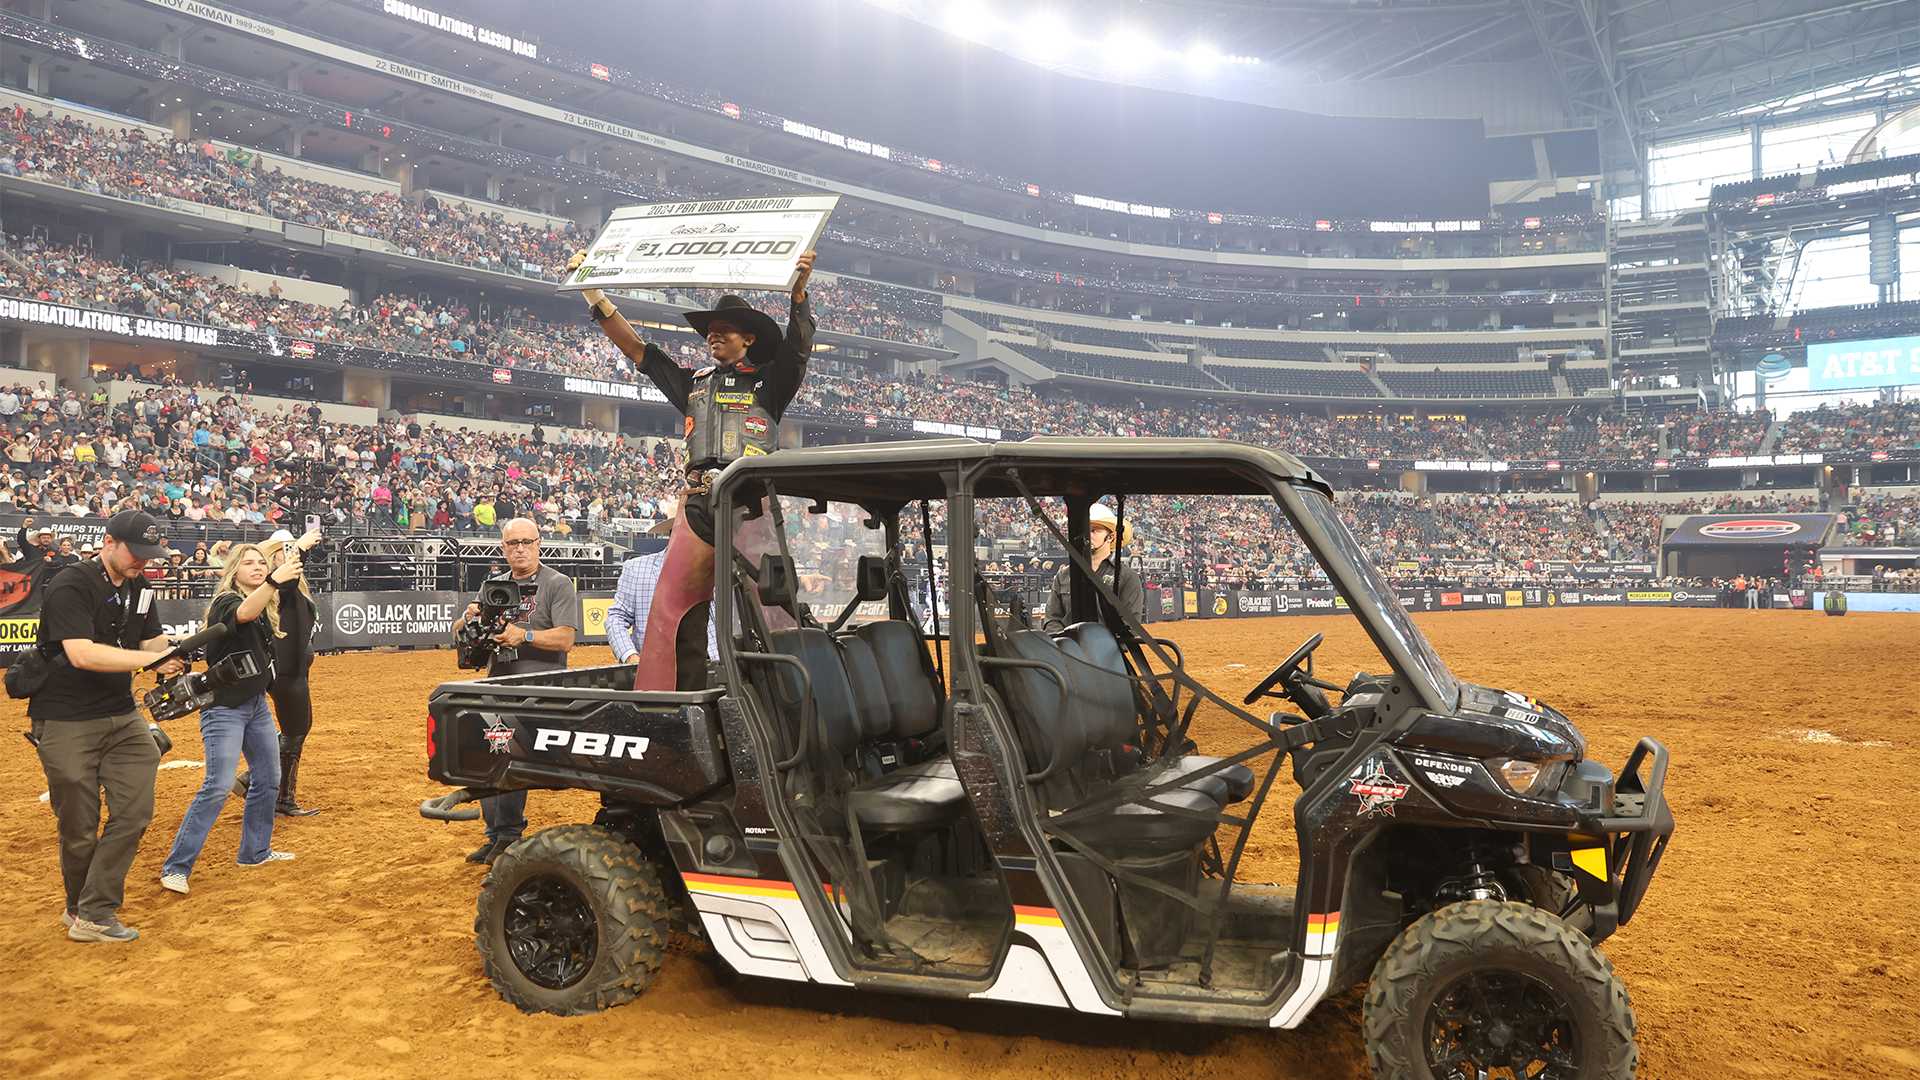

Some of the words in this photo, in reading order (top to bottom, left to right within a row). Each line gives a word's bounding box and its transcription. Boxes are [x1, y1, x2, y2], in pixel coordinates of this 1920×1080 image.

[186, 3, 233, 25] AIKMAN
[478, 27, 512, 50] CASSIO
[376, 59, 386, 71] 22
[390, 63, 429, 82] EMMITT
[431, 73, 461, 92] SMITH
[563, 112, 575, 123] 73
[577, 116, 605, 133] LARRY
[607, 123, 634, 139] ALLEN
[724, 155, 735, 165] 94
[777, 168, 799, 181] WARE
[647, 205, 674, 217] 2024
[677, 203, 698, 214] PBR
[699, 200, 734, 213] WORLD
[735, 198, 793, 211] CHAMPION
[637, 240, 797, 258] $1,000,000
[0, 300, 133, 337] CONGRATULATIONS,
[136, 319, 183, 343] CASSIO
[184, 325, 218, 346] DIAS!
[1822, 351, 1900, 379] AT&T
[50, 524, 86, 533] RAMPS
[87, 525, 106, 534] THA
[1486, 593, 1501, 604] YETI
[367, 604, 412, 621] BLACK
[416, 604, 452, 620] RIFLE
[0, 623, 39, 639] ORGA
[367, 622, 403, 634] COFFEE
[406, 621, 453, 634] COMPANY
[533, 728, 650, 760] PBR
[1414, 757, 1473, 775] DEFENDER
[1354, 783, 1405, 796] PBR
